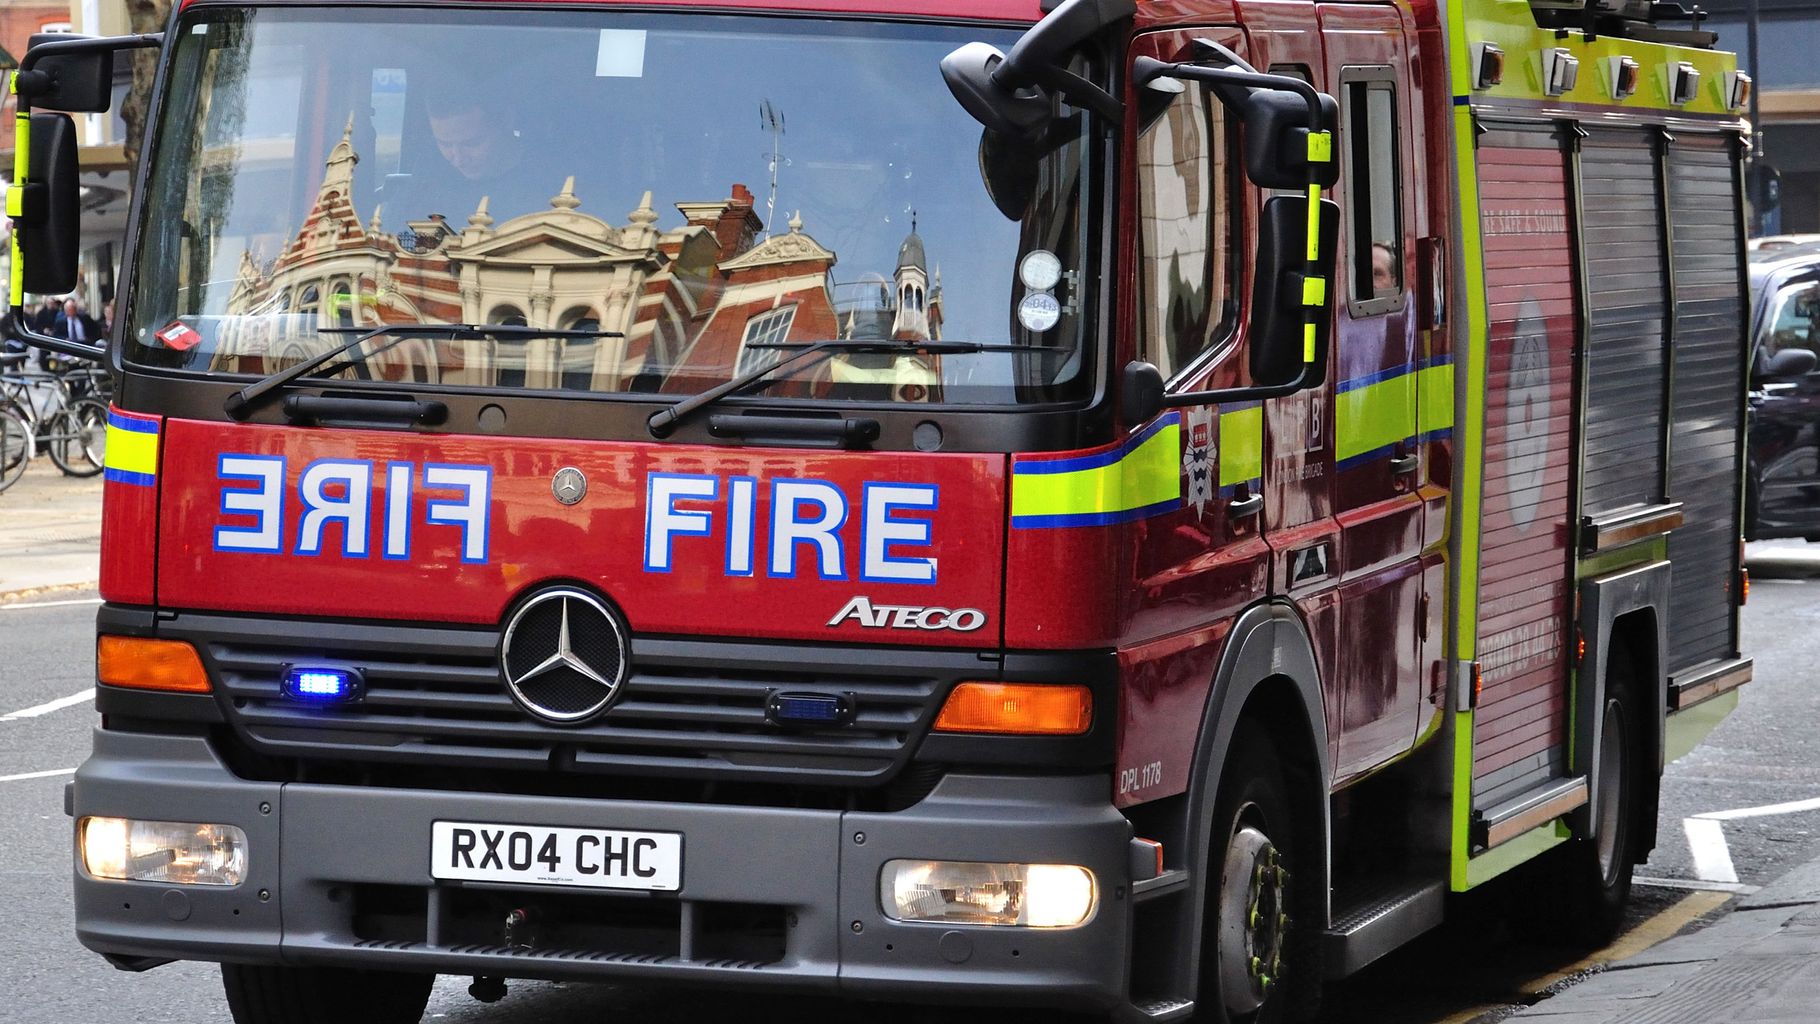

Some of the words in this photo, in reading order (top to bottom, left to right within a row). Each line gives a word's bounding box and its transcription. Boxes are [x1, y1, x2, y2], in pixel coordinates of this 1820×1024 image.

[644, 472, 939, 585] FIRE
[825, 596, 986, 631] ATEGO
[1120, 767, 1140, 794] DPL
[1142, 760, 1161, 789] 1178
[451, 828, 561, 873] RX04
[575, 834, 658, 878] CHC
